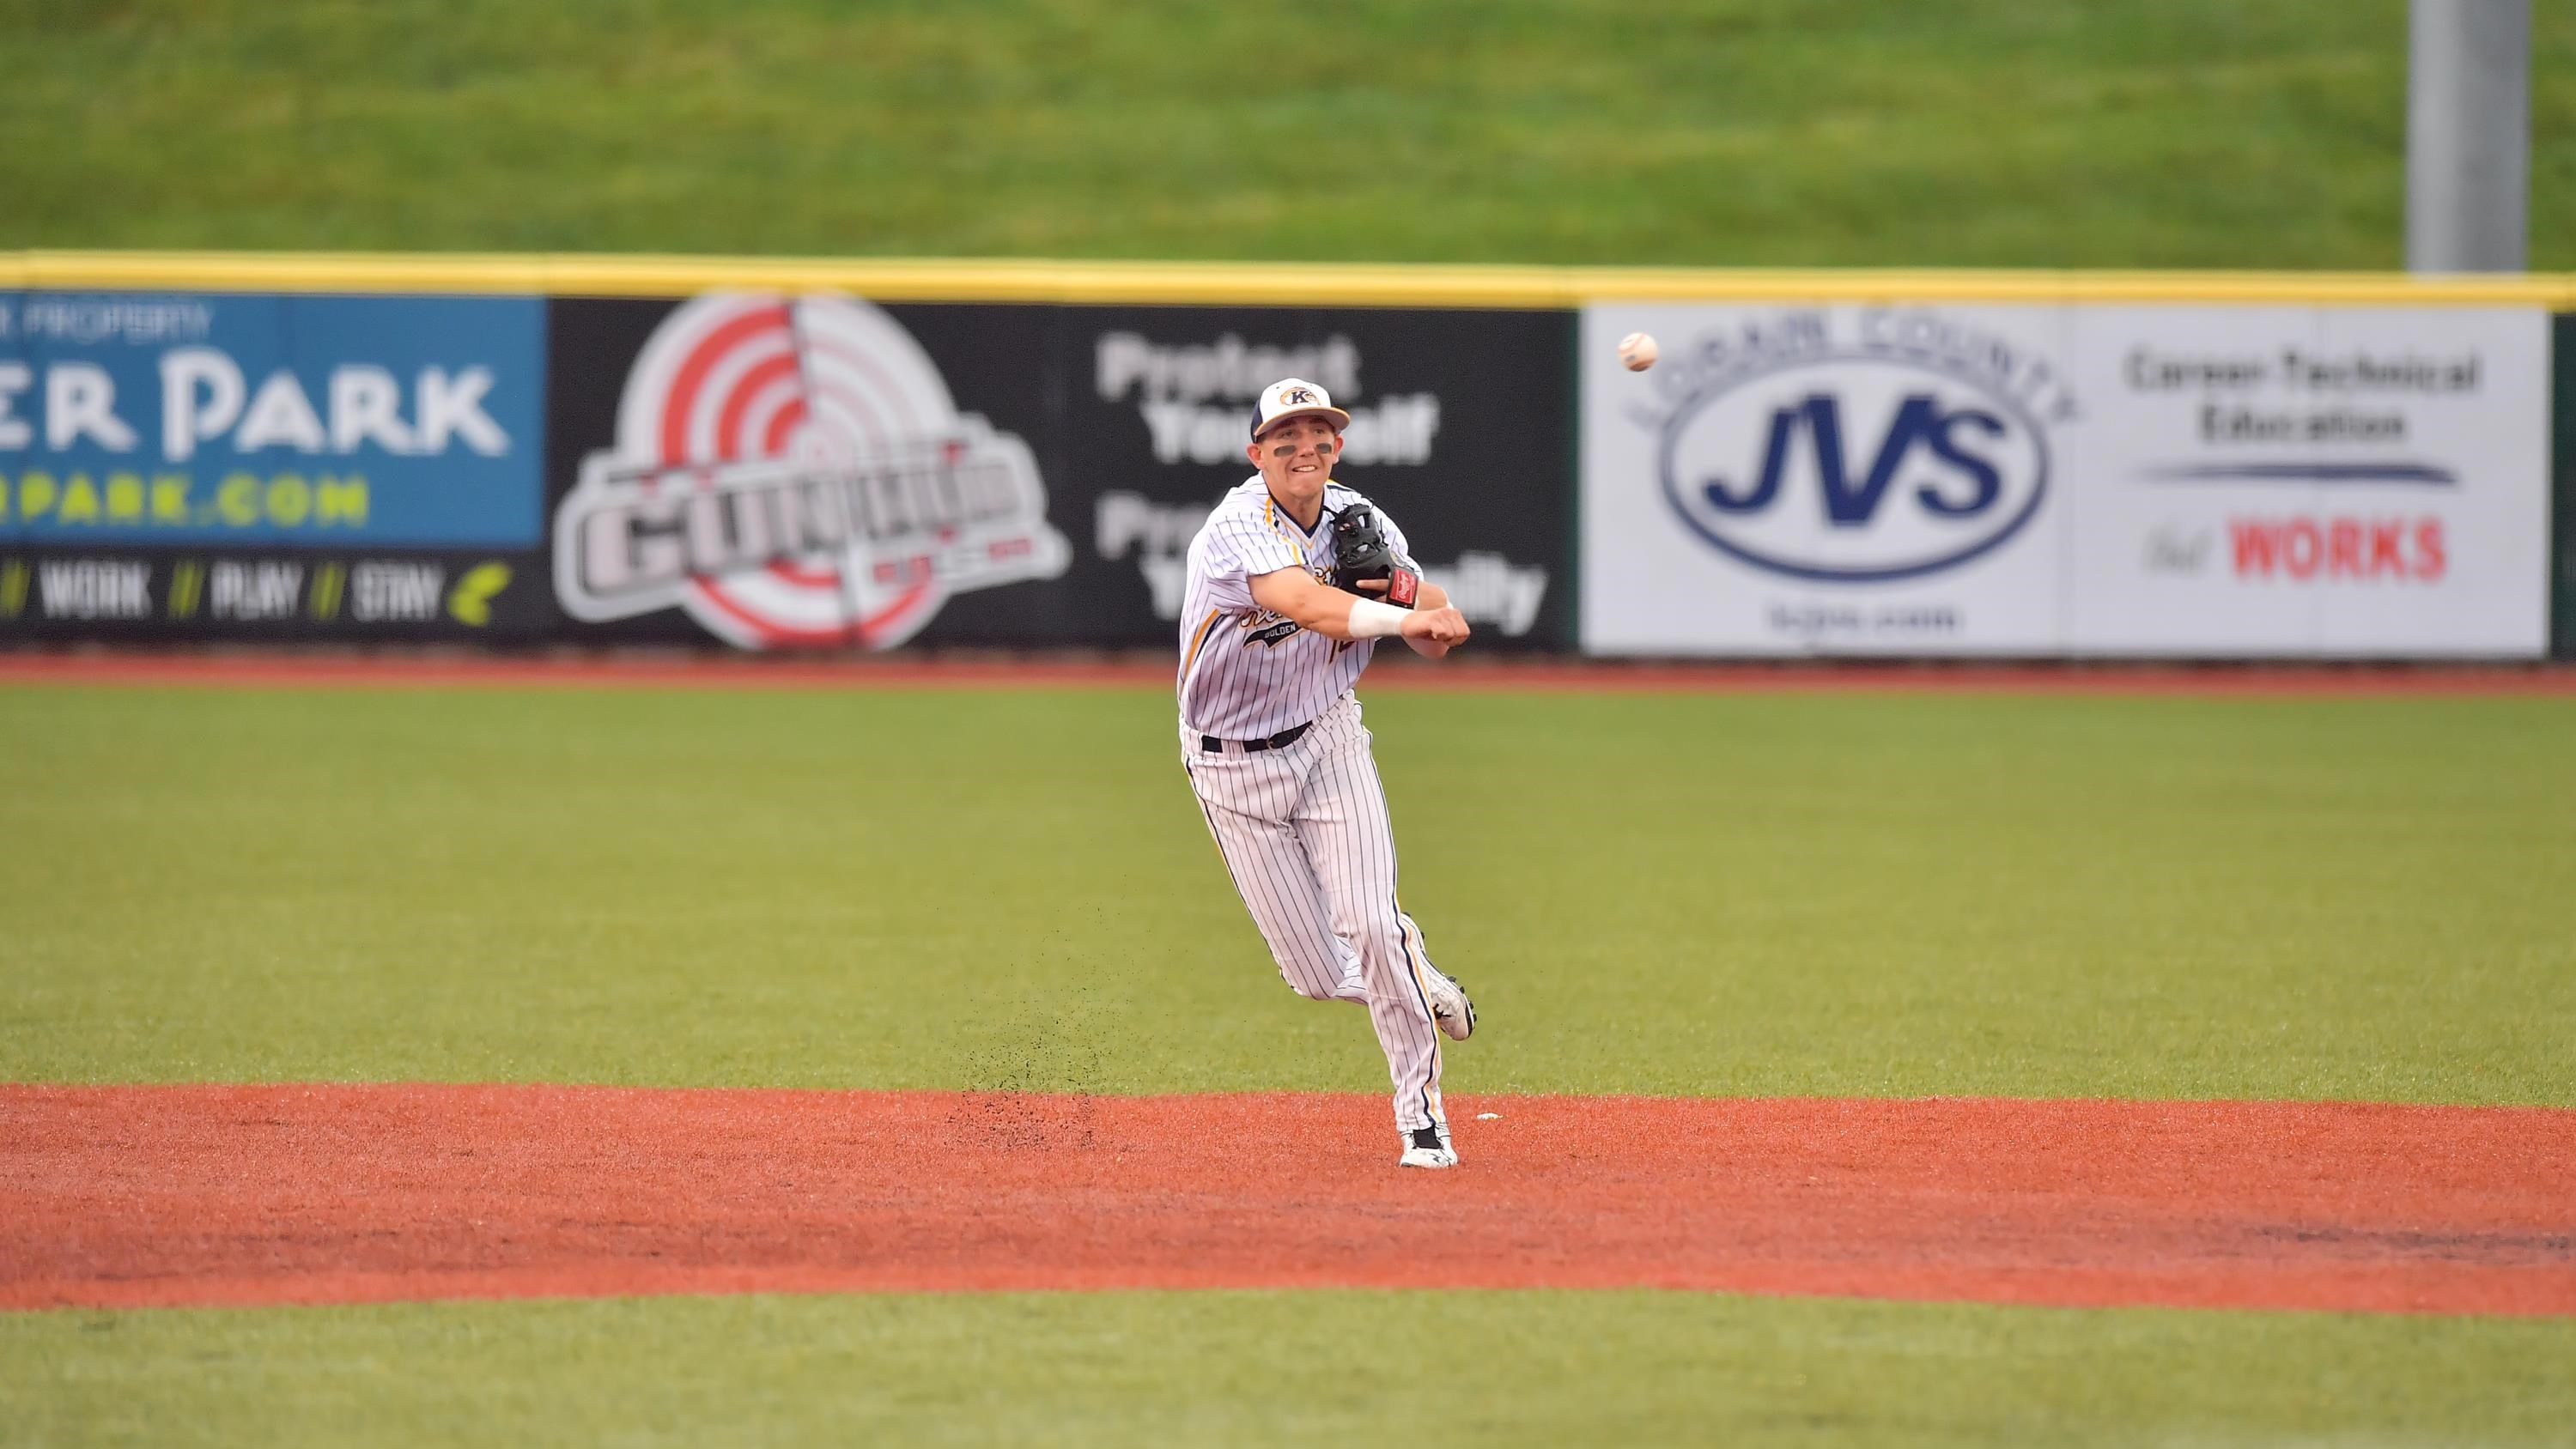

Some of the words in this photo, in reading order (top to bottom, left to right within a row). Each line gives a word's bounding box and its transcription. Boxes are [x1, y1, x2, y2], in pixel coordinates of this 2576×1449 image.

[1291, 391, 1309, 404] K
[1858, 307, 2085, 423] COUNTY
[158, 346, 513, 464] PARK
[2196, 403, 2409, 445] Education
[1702, 392, 2008, 529] JVS
[0, 470, 370, 527] PARK.COM
[2227, 516, 2449, 583] WORKS
[39, 560, 153, 620] WORK
[210, 559, 305, 621] PLAY
[350, 559, 445, 622] STAY
